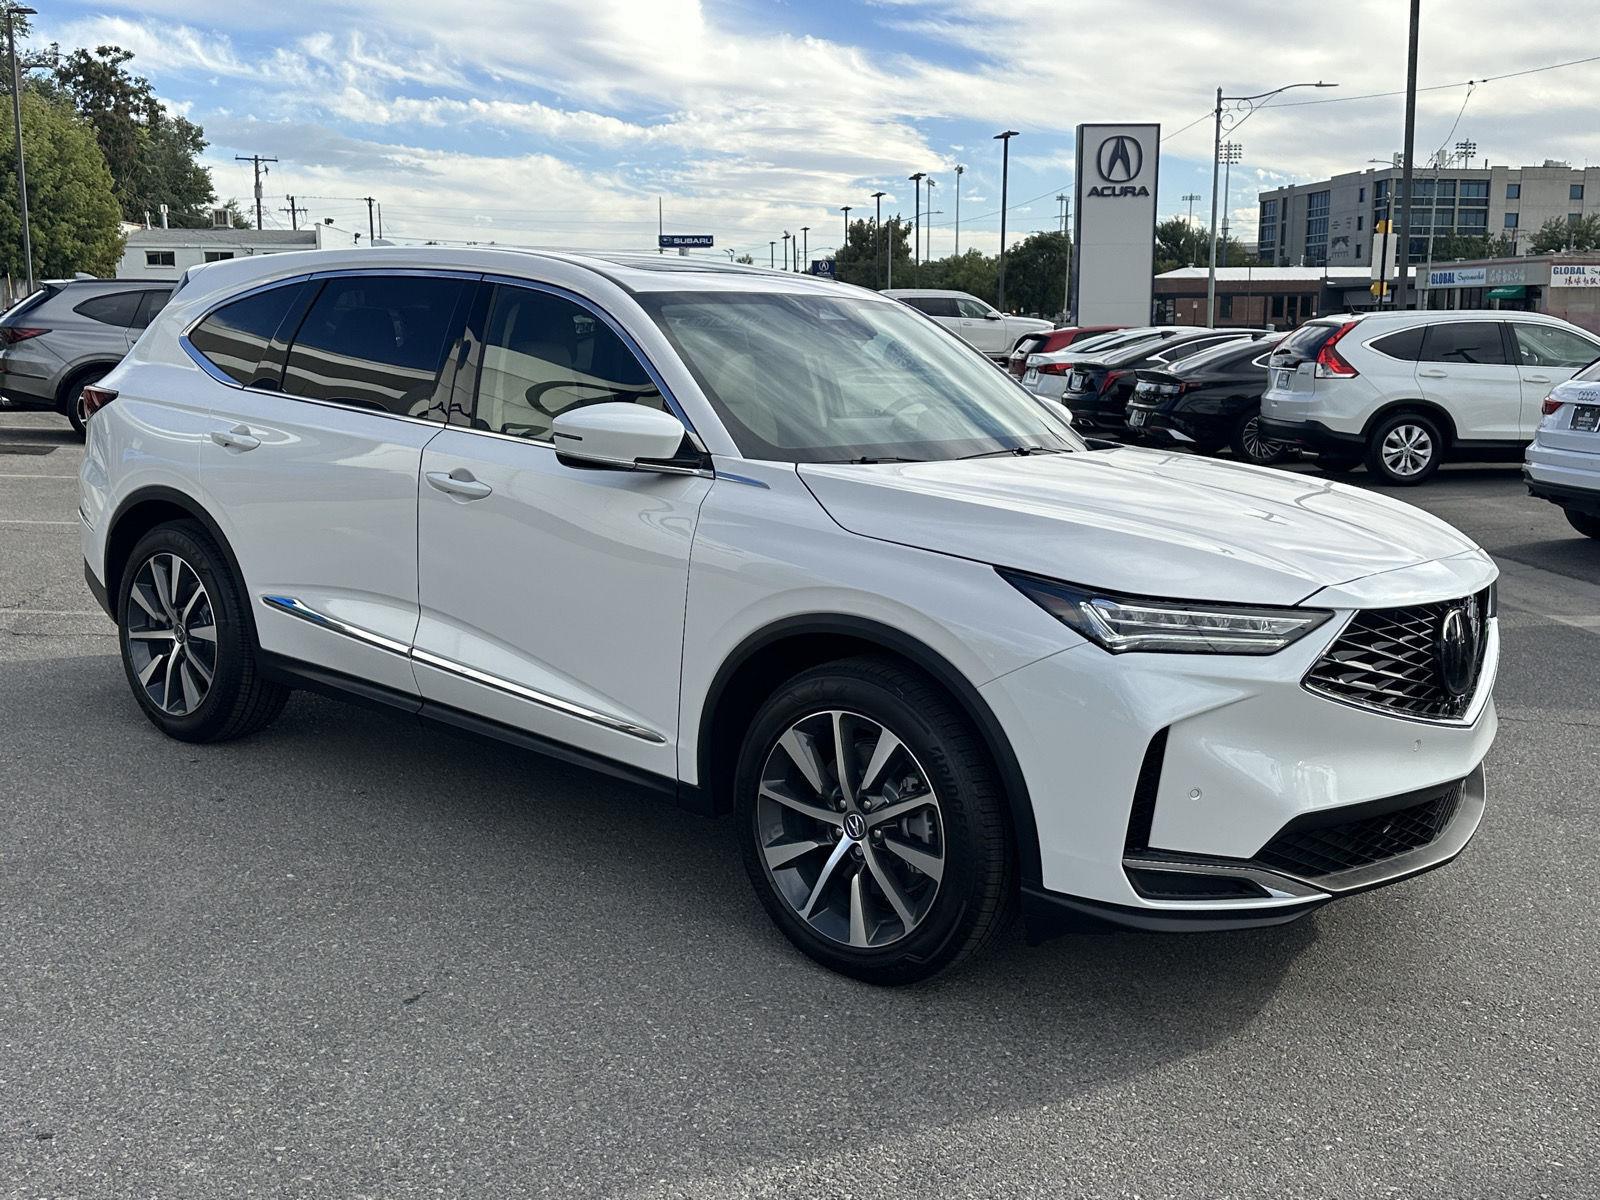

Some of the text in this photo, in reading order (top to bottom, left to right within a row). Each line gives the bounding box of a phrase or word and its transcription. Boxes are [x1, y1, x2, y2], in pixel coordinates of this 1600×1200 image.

[1087, 185, 1150, 197] ACURA
[1553, 266, 1586, 275] GLOBAL
[1431, 272, 1456, 284] GLOBAL
